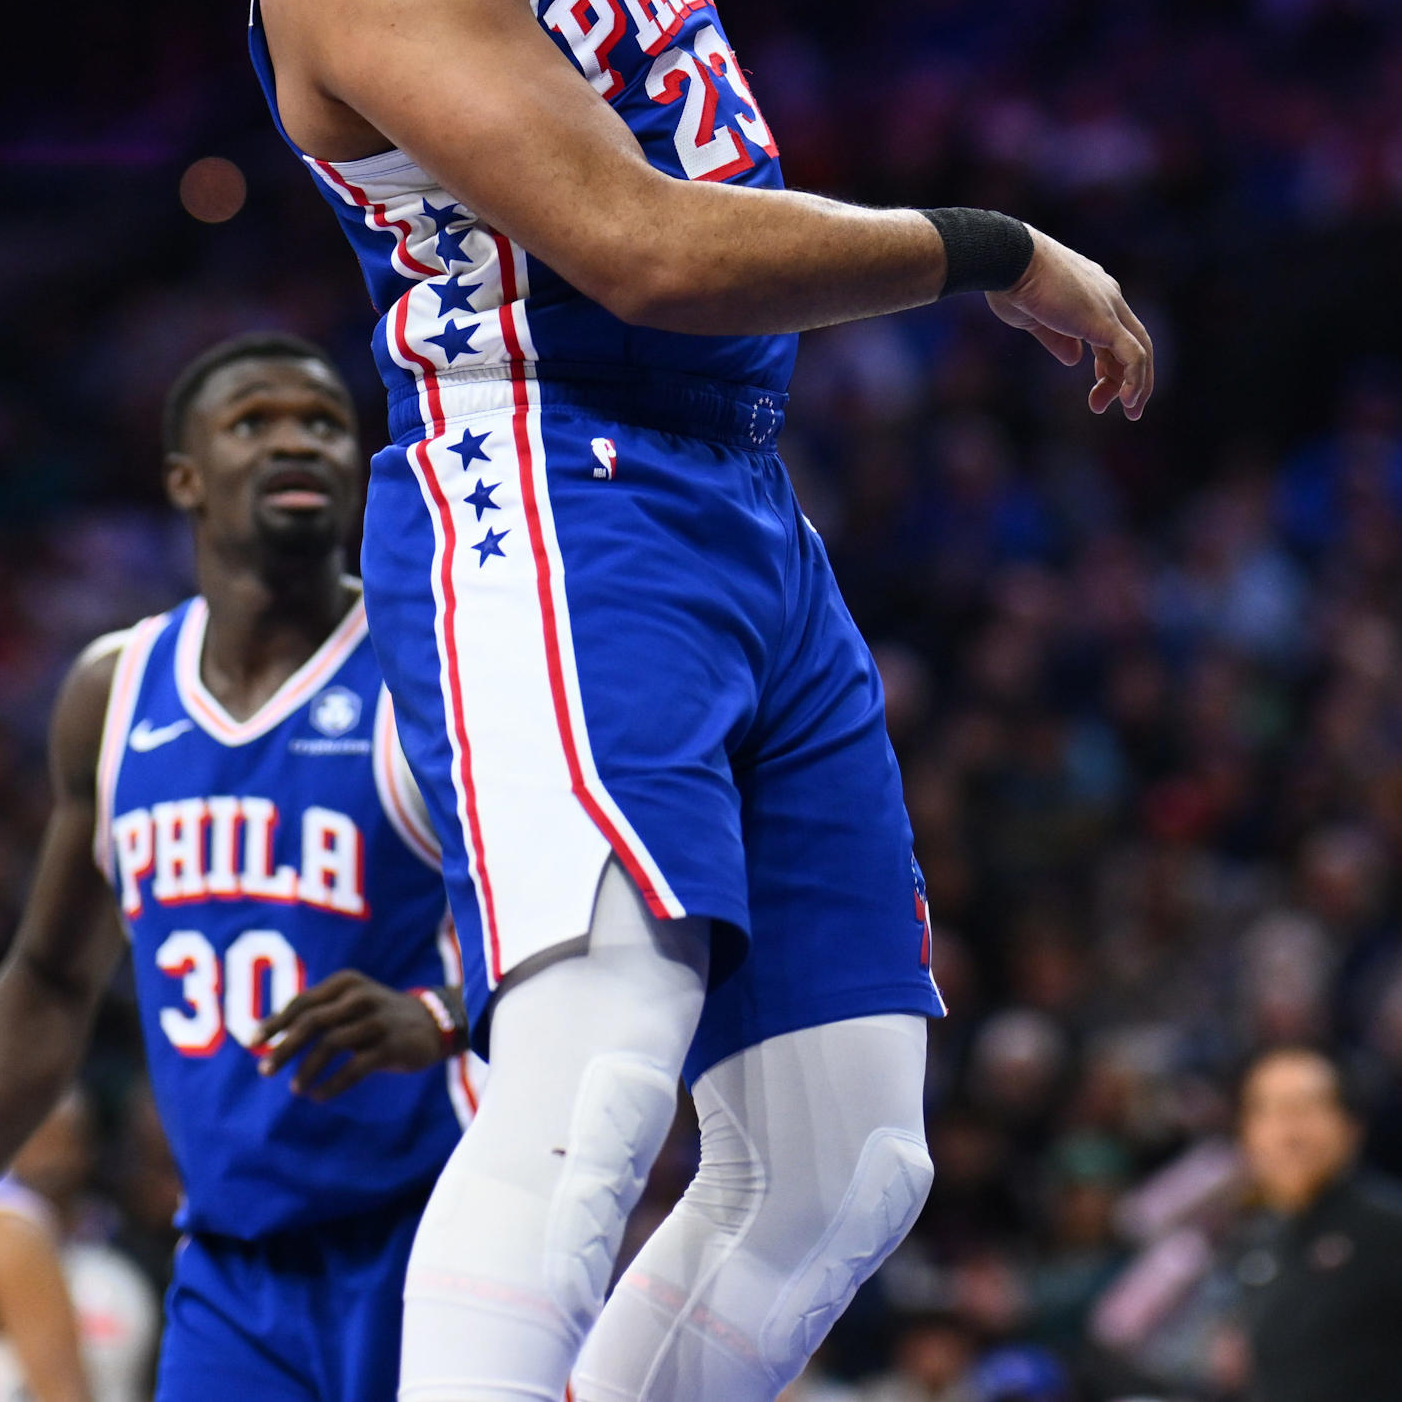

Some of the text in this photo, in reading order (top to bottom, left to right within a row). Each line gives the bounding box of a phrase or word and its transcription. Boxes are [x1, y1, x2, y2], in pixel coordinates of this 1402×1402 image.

[644, 24, 780, 182] 23
[112, 796, 370, 920] PHILA
[155, 929, 306, 1056] 30
